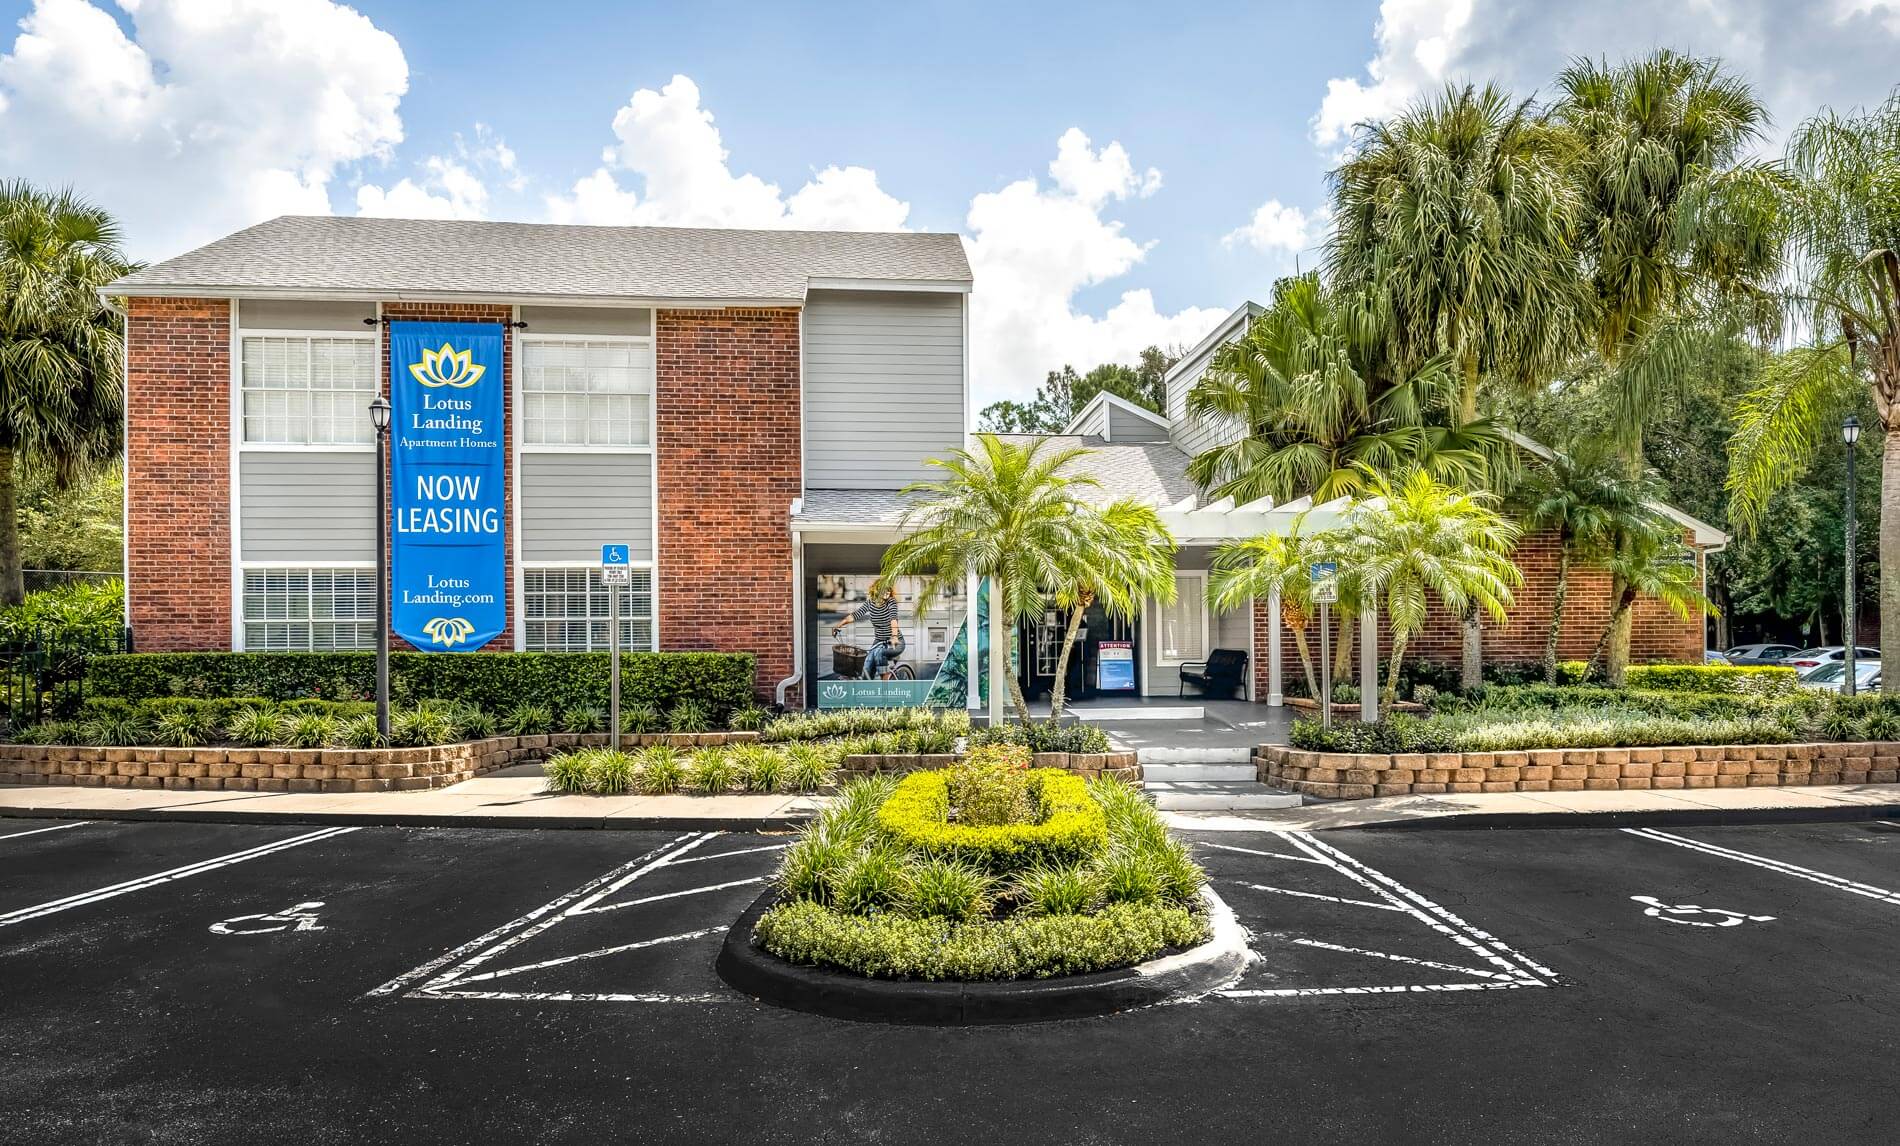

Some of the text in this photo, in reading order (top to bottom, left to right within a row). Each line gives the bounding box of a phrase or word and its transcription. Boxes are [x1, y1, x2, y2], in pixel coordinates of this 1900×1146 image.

[423, 394, 472, 410] Lotus
[412, 413, 483, 435] Landing
[399, 436, 497, 450] Apartment Homes
[417, 475, 480, 500] NOW
[397, 508, 498, 533] LEASING
[427, 574, 470, 588] Lotus
[402, 590, 494, 608] Landing.com
[851, 687, 876, 696] Lotus
